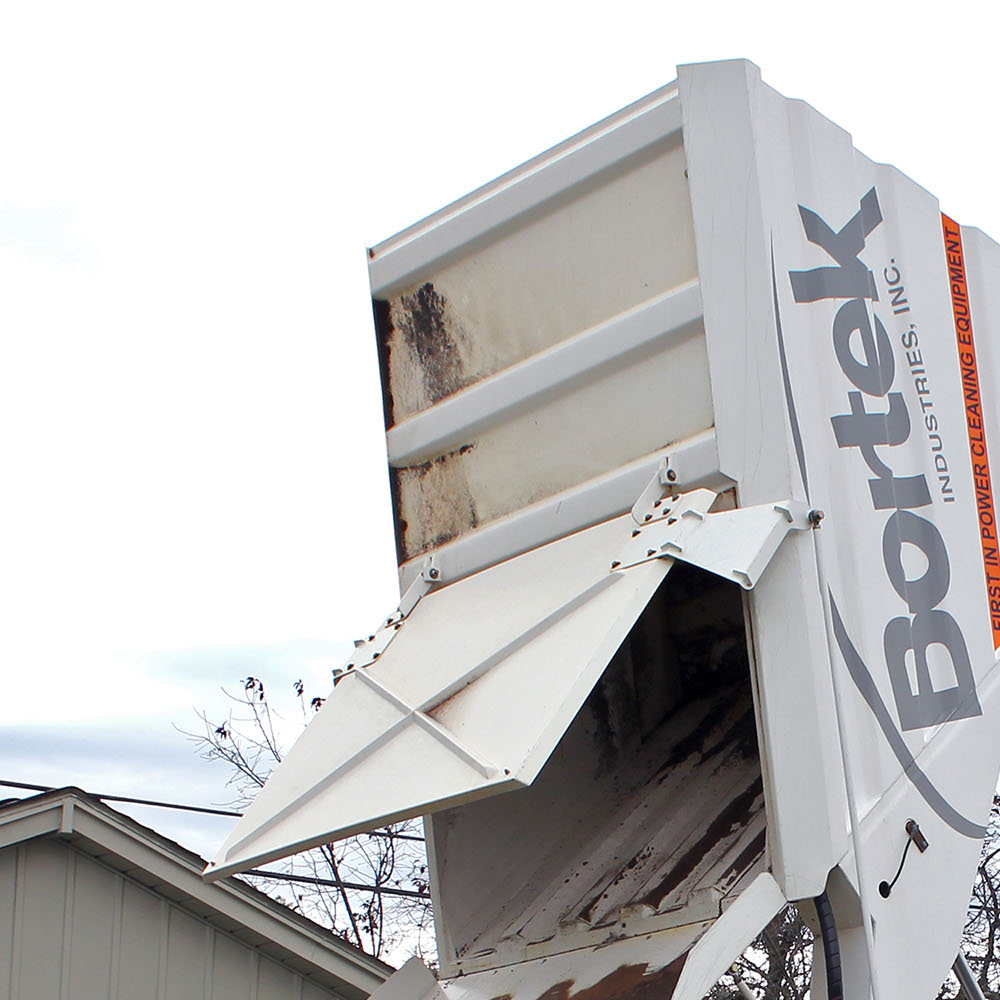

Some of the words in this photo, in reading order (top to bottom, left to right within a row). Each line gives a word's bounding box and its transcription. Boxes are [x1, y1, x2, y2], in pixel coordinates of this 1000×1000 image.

[884, 258, 910, 315] INC.
[945, 226, 972, 346] EQUIPMENT
[901, 323, 955, 502] INDUSTRIES,
[960, 352, 984, 457] CLEANING
[788, 186, 982, 732] Bortek
[974, 463, 995, 540] POWER
[984, 547, 999, 566] IN
